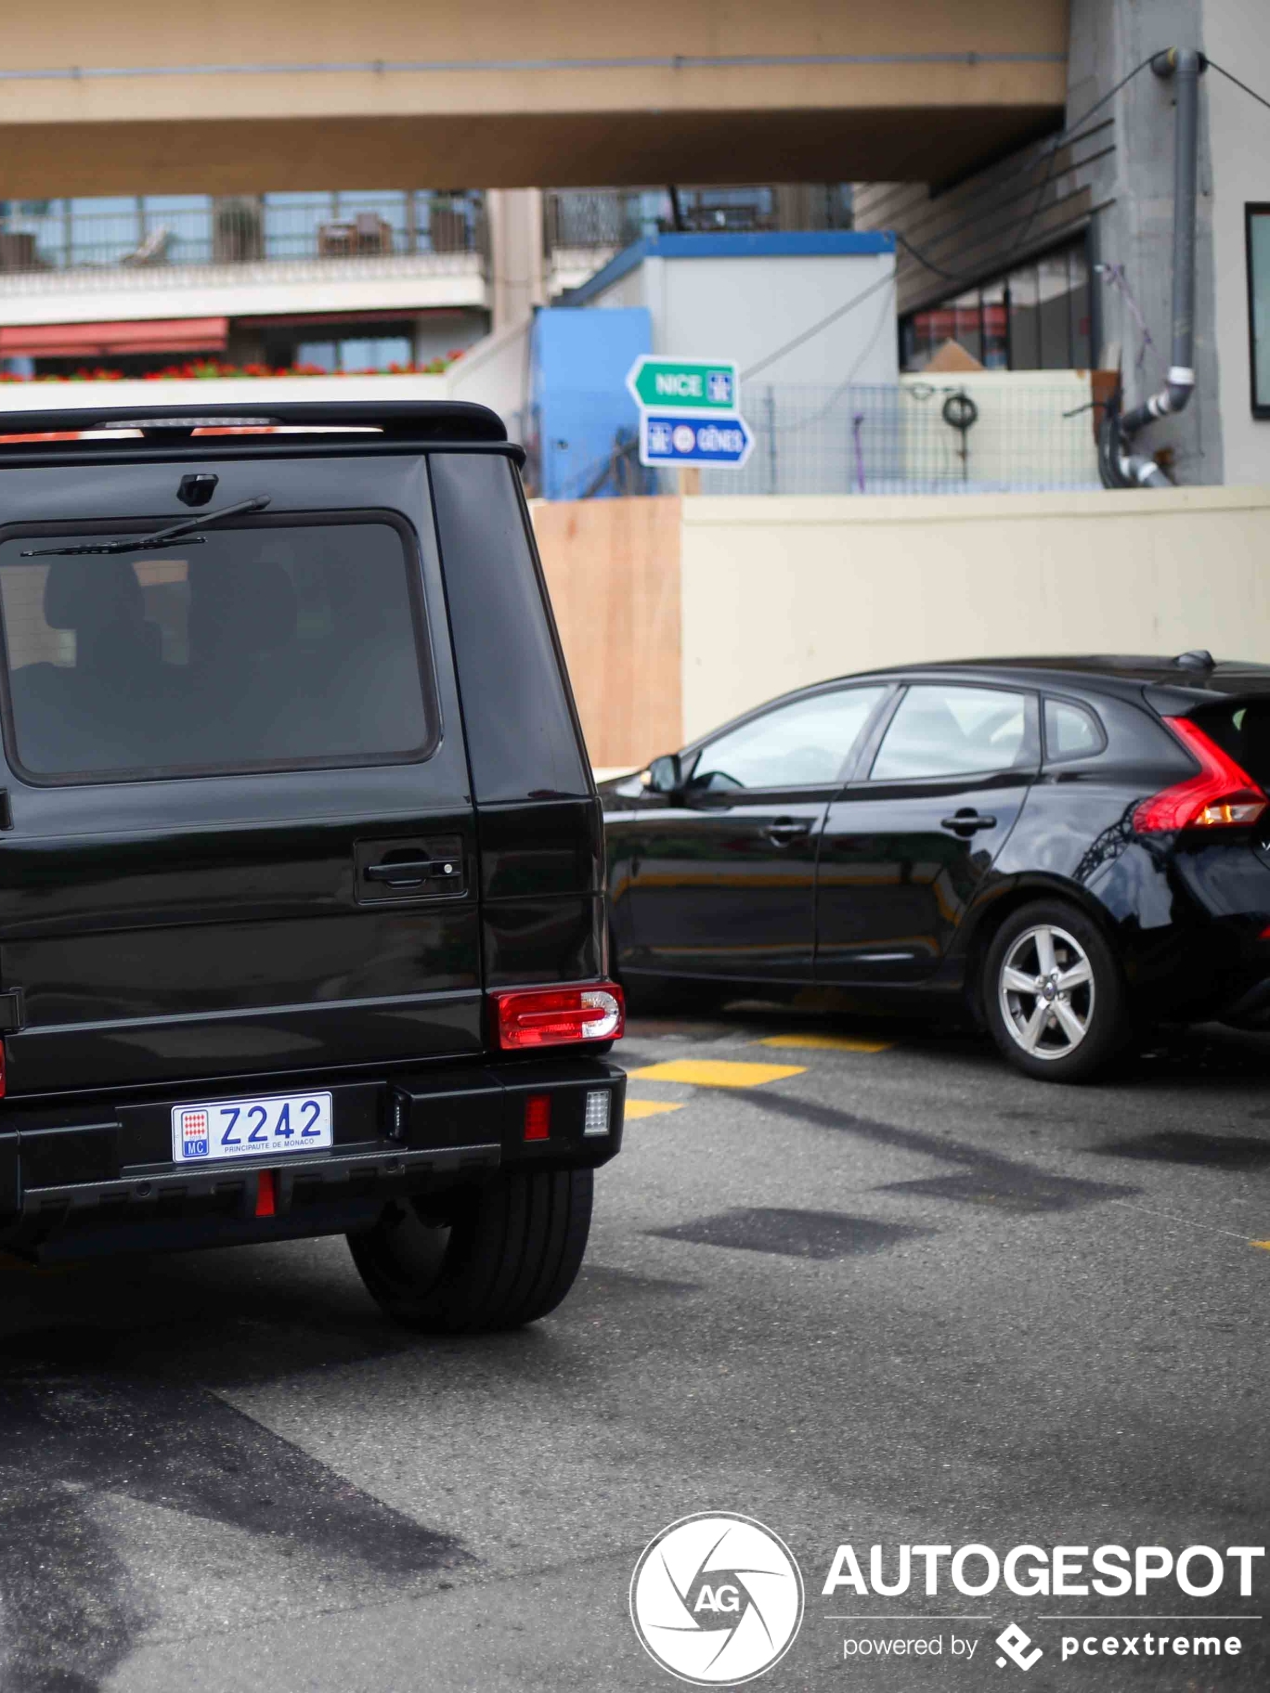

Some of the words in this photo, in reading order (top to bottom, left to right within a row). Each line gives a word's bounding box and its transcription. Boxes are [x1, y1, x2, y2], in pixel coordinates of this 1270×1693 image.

[655, 373, 703, 397] NICE
[220, 1100, 321, 1145] Z242
[188, 1141, 204, 1154] MC
[224, 1144, 270, 1153] PRINCIPAUTE
[283, 1138, 315, 1147] MONACO
